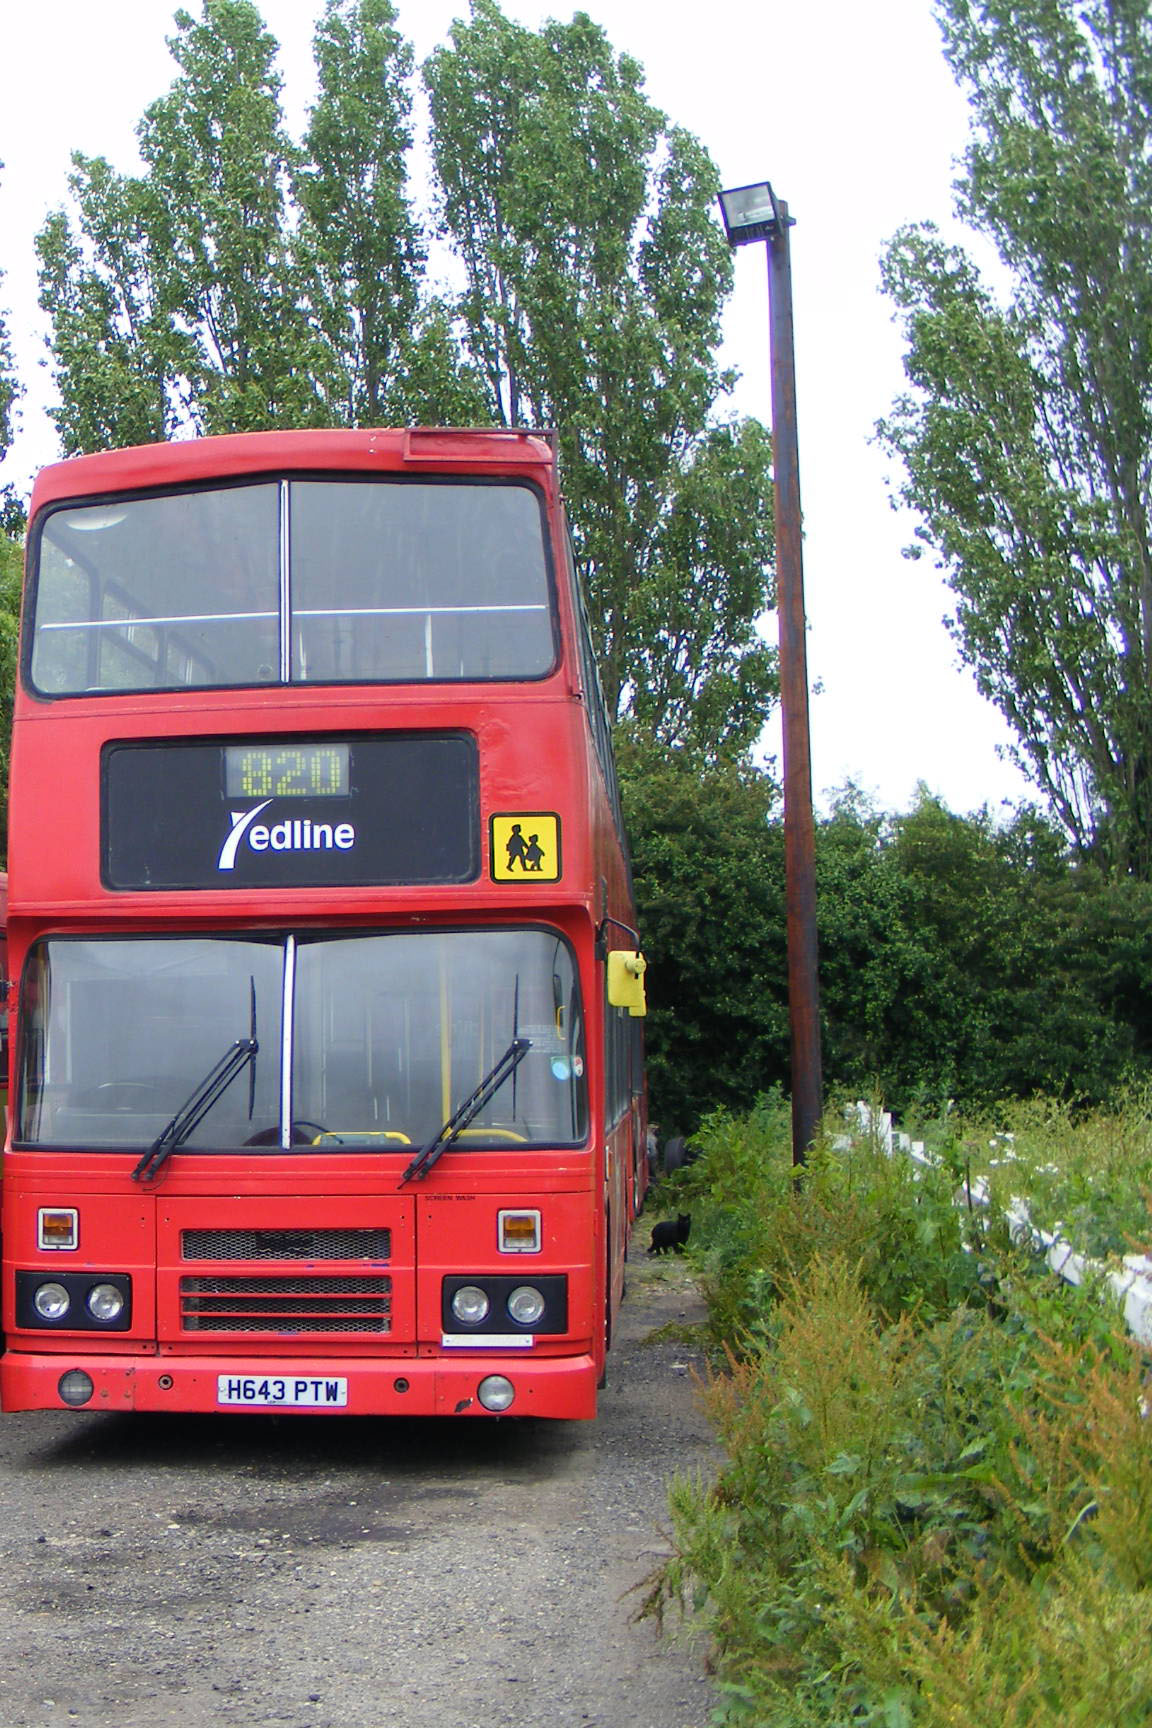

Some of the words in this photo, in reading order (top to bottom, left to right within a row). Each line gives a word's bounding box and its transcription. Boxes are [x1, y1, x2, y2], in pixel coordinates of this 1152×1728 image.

[242, 750, 340, 796] 820
[228, 1379, 286, 1401] H643
[294, 1380, 339, 1402] PTW
